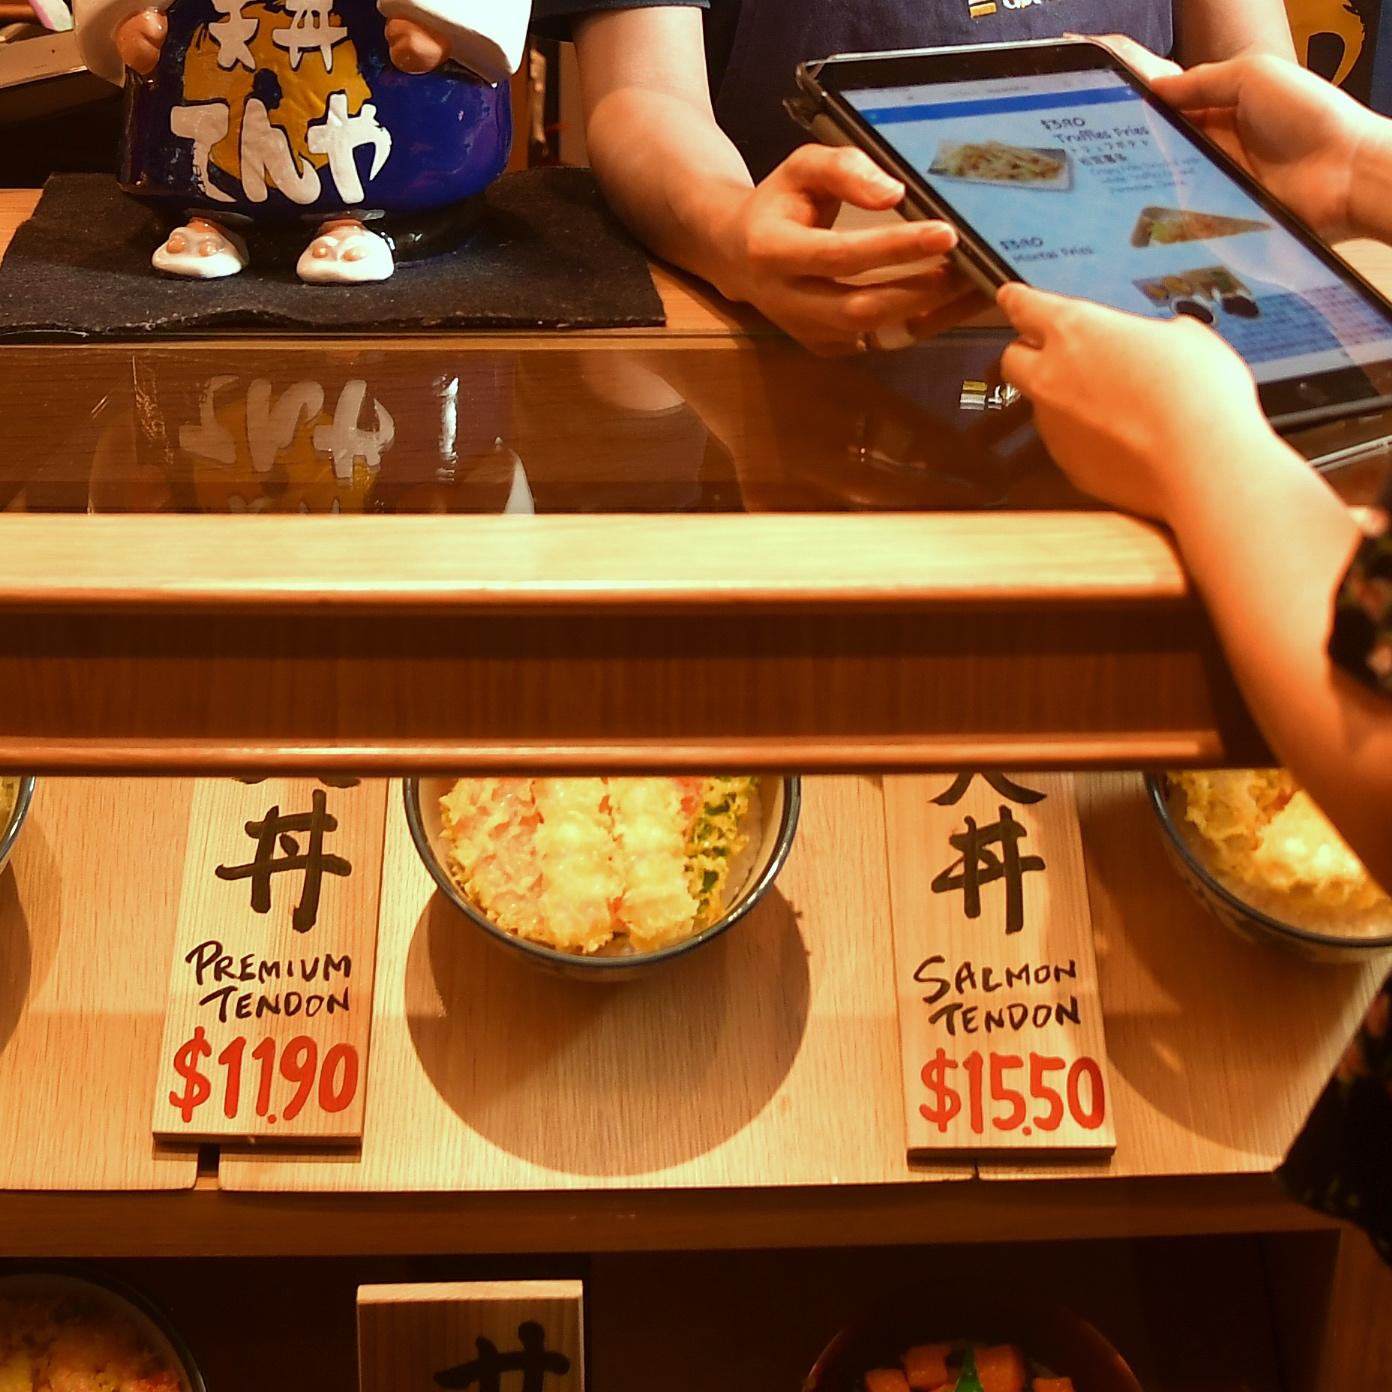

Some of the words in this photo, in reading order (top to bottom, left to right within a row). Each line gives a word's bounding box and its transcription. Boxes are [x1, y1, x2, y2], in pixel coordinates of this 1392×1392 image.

[170, 89, 394, 205] てんや
[1112, 125, 1150, 138] Fries
[928, 995, 1082, 1037] TENDON
[168, 1026, 360, 1124] $11.90
[918, 1047, 1107, 1137] $15.50
